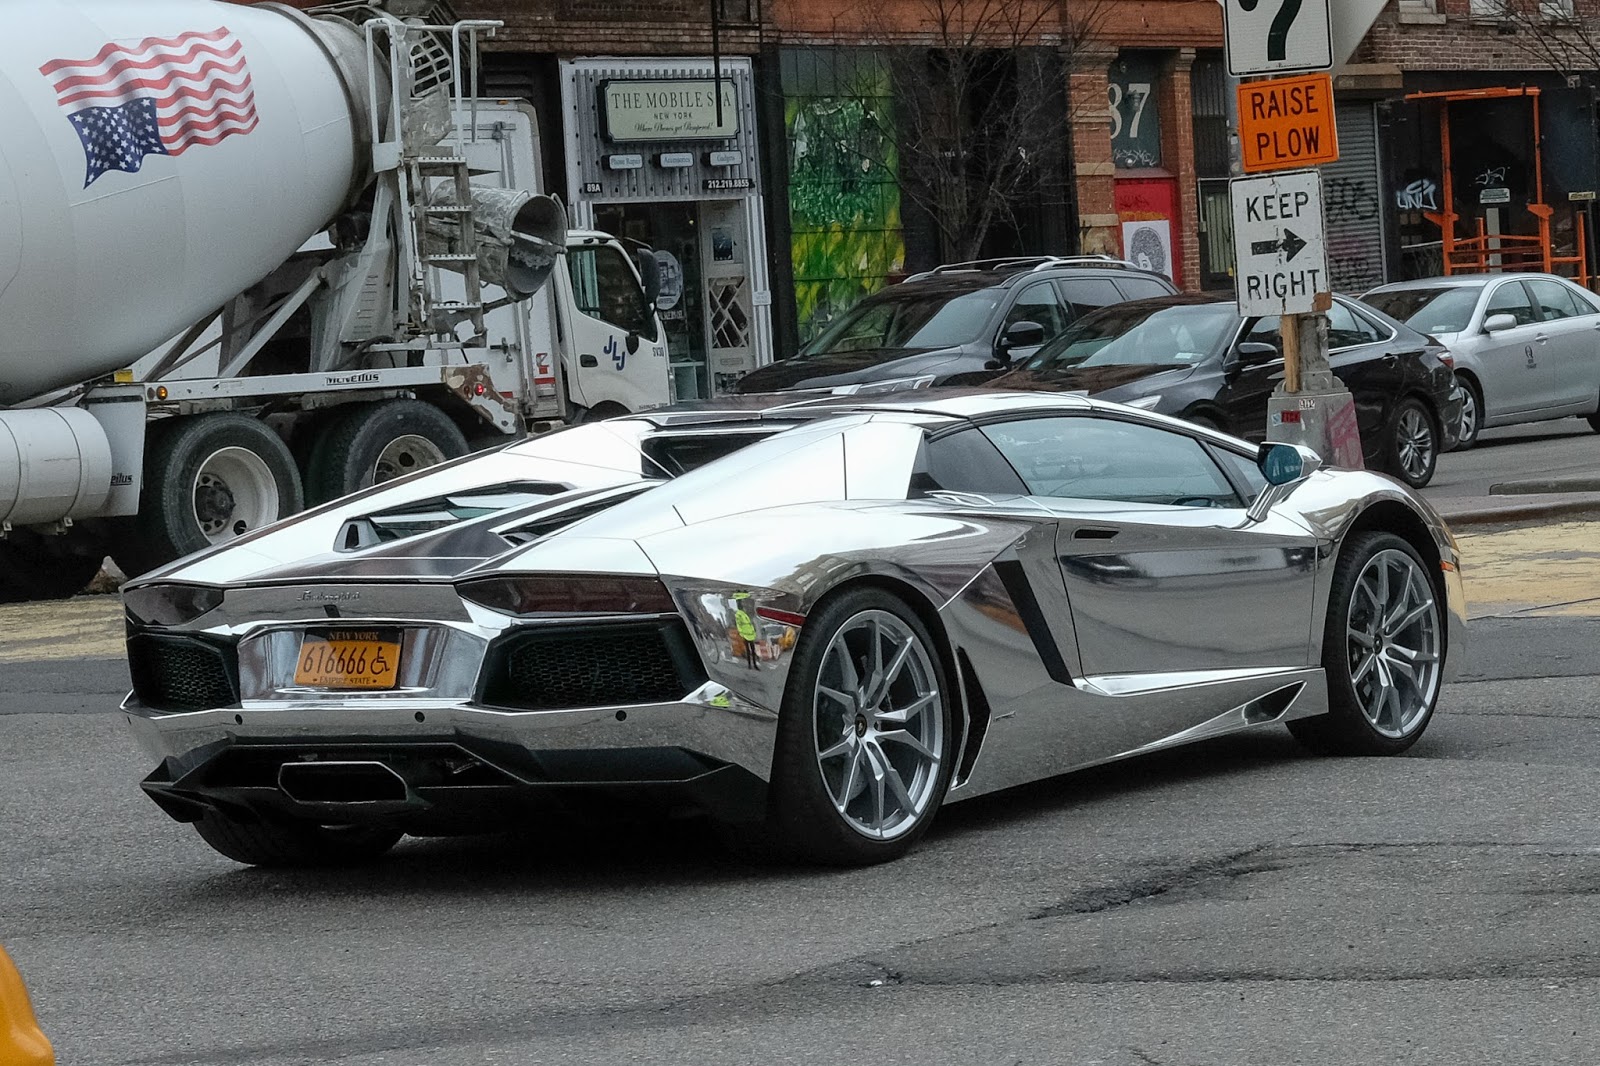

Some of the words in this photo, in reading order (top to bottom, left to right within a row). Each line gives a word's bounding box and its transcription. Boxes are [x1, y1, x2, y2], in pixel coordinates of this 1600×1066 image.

[611, 92, 642, 109] THE
[646, 91, 703, 108] MOBILE
[707, 91, 731, 107] SA
[1252, 85, 1319, 120] RAISE
[654, 112, 669, 120] NEW
[673, 112, 693, 120] YORK
[1257, 126, 1320, 160] PLOW
[1246, 191, 1309, 223] KEEP
[1247, 269, 1320, 300] RIGHT
[329, 631, 351, 641] NEW
[353, 631, 379, 641] YORK
[303, 646, 368, 675] 616666
[350, 676, 371, 685] STATE
